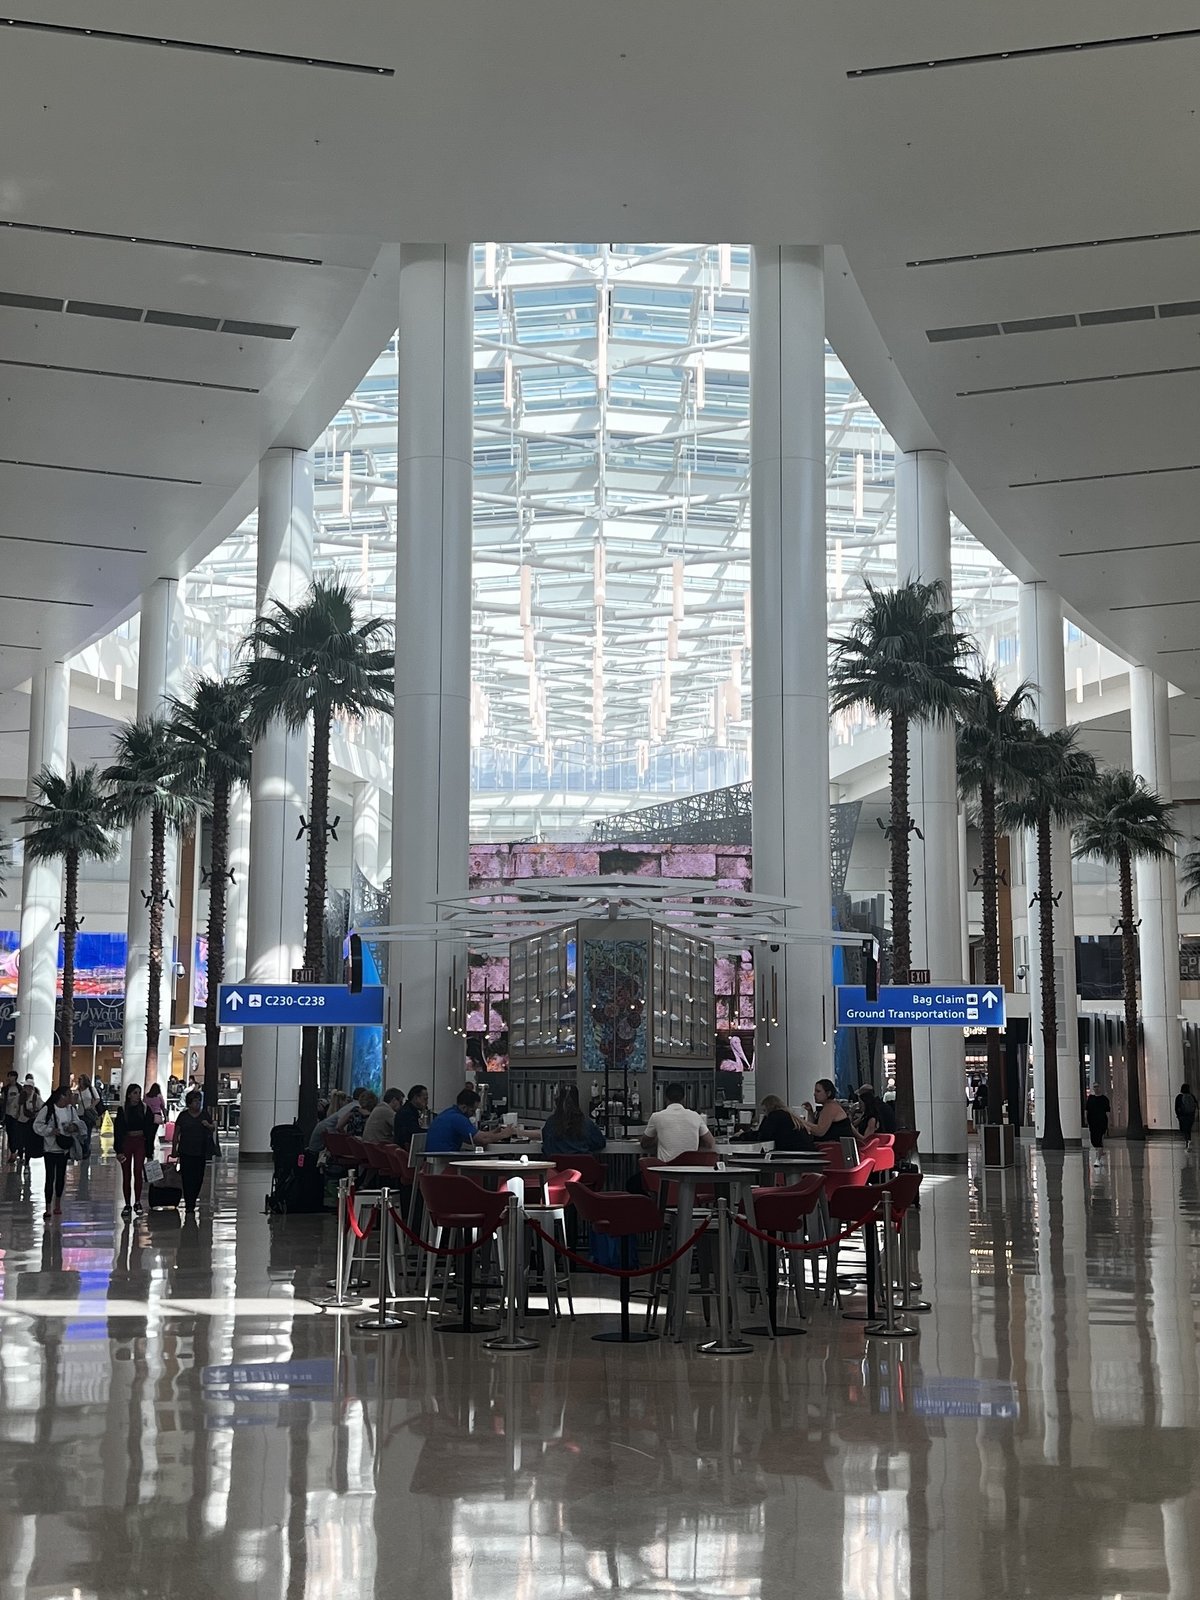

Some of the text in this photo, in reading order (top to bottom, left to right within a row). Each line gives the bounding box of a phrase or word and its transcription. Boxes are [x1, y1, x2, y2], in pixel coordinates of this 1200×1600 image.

[295, 970, 312, 981] EXIT
[910, 971, 928, 983] EXIT
[265, 996, 325, 1006] C230-C238
[913, 994, 965, 1005] Bag Claim
[847, 1009, 965, 1020] Ground Transportation
